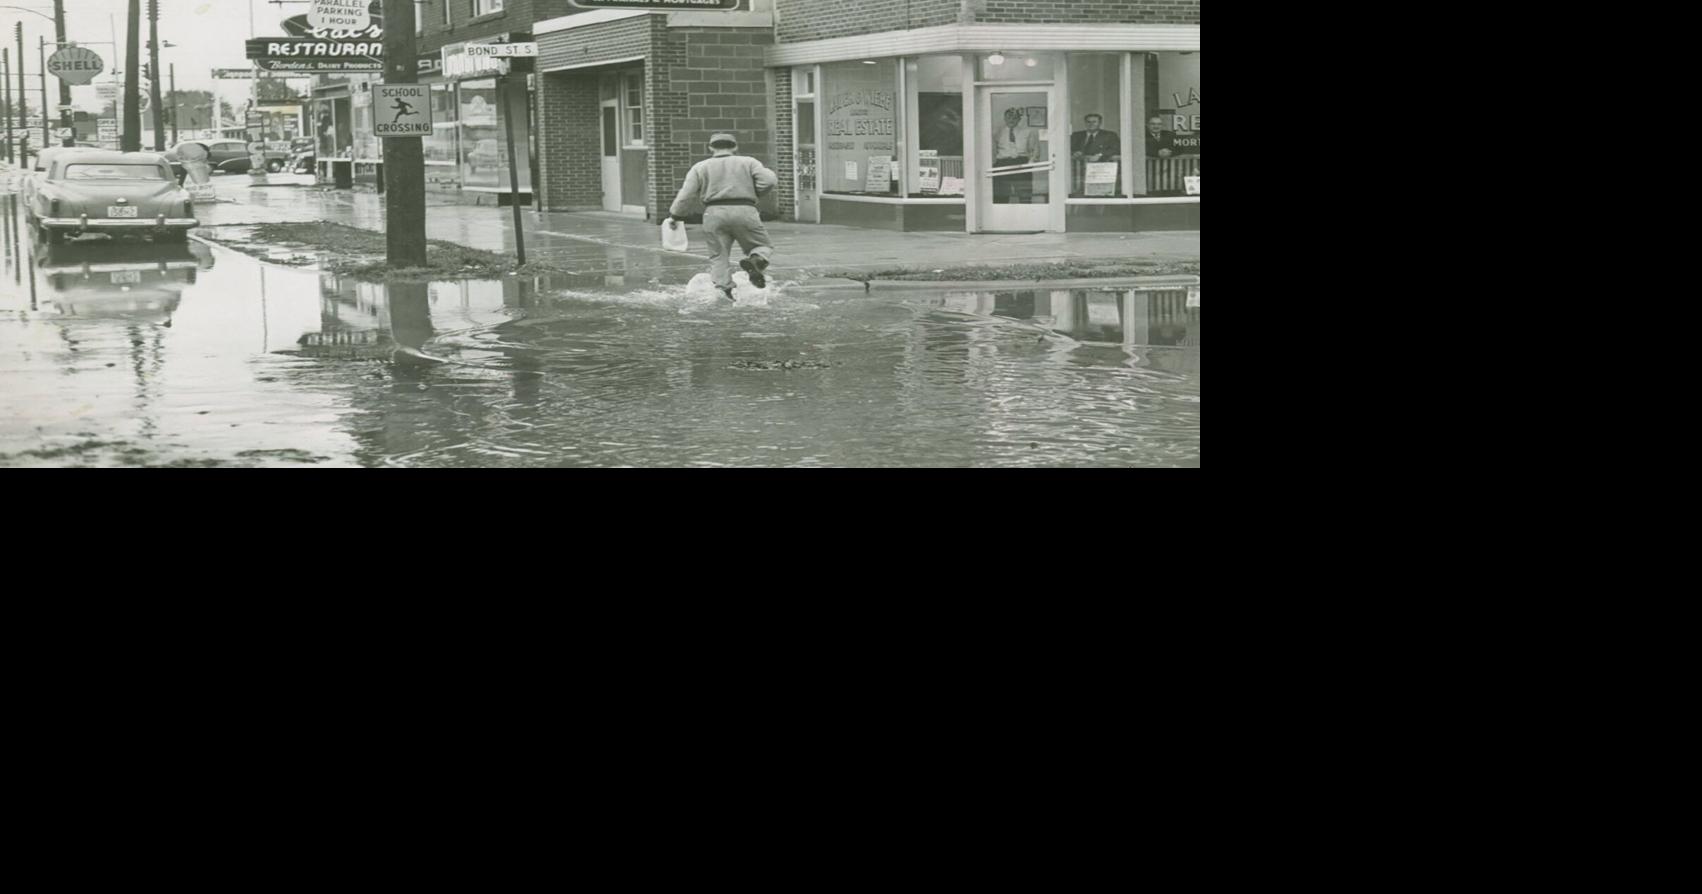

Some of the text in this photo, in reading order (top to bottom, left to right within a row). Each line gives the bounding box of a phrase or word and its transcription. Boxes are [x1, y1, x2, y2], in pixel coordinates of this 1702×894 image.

[316, 7, 362, 16] PARKING
[329, 17, 357, 25] HOUR
[267, 42, 383, 56] RESTAURAN
[468, 46, 498, 56] BOND
[524, 45, 532, 54] S
[51, 60, 100, 71] SHELL
[382, 87, 424, 97] SCHOOL
[376, 122, 430, 133] CROSSING
[828, 119, 893, 136] REAL ESTATE
